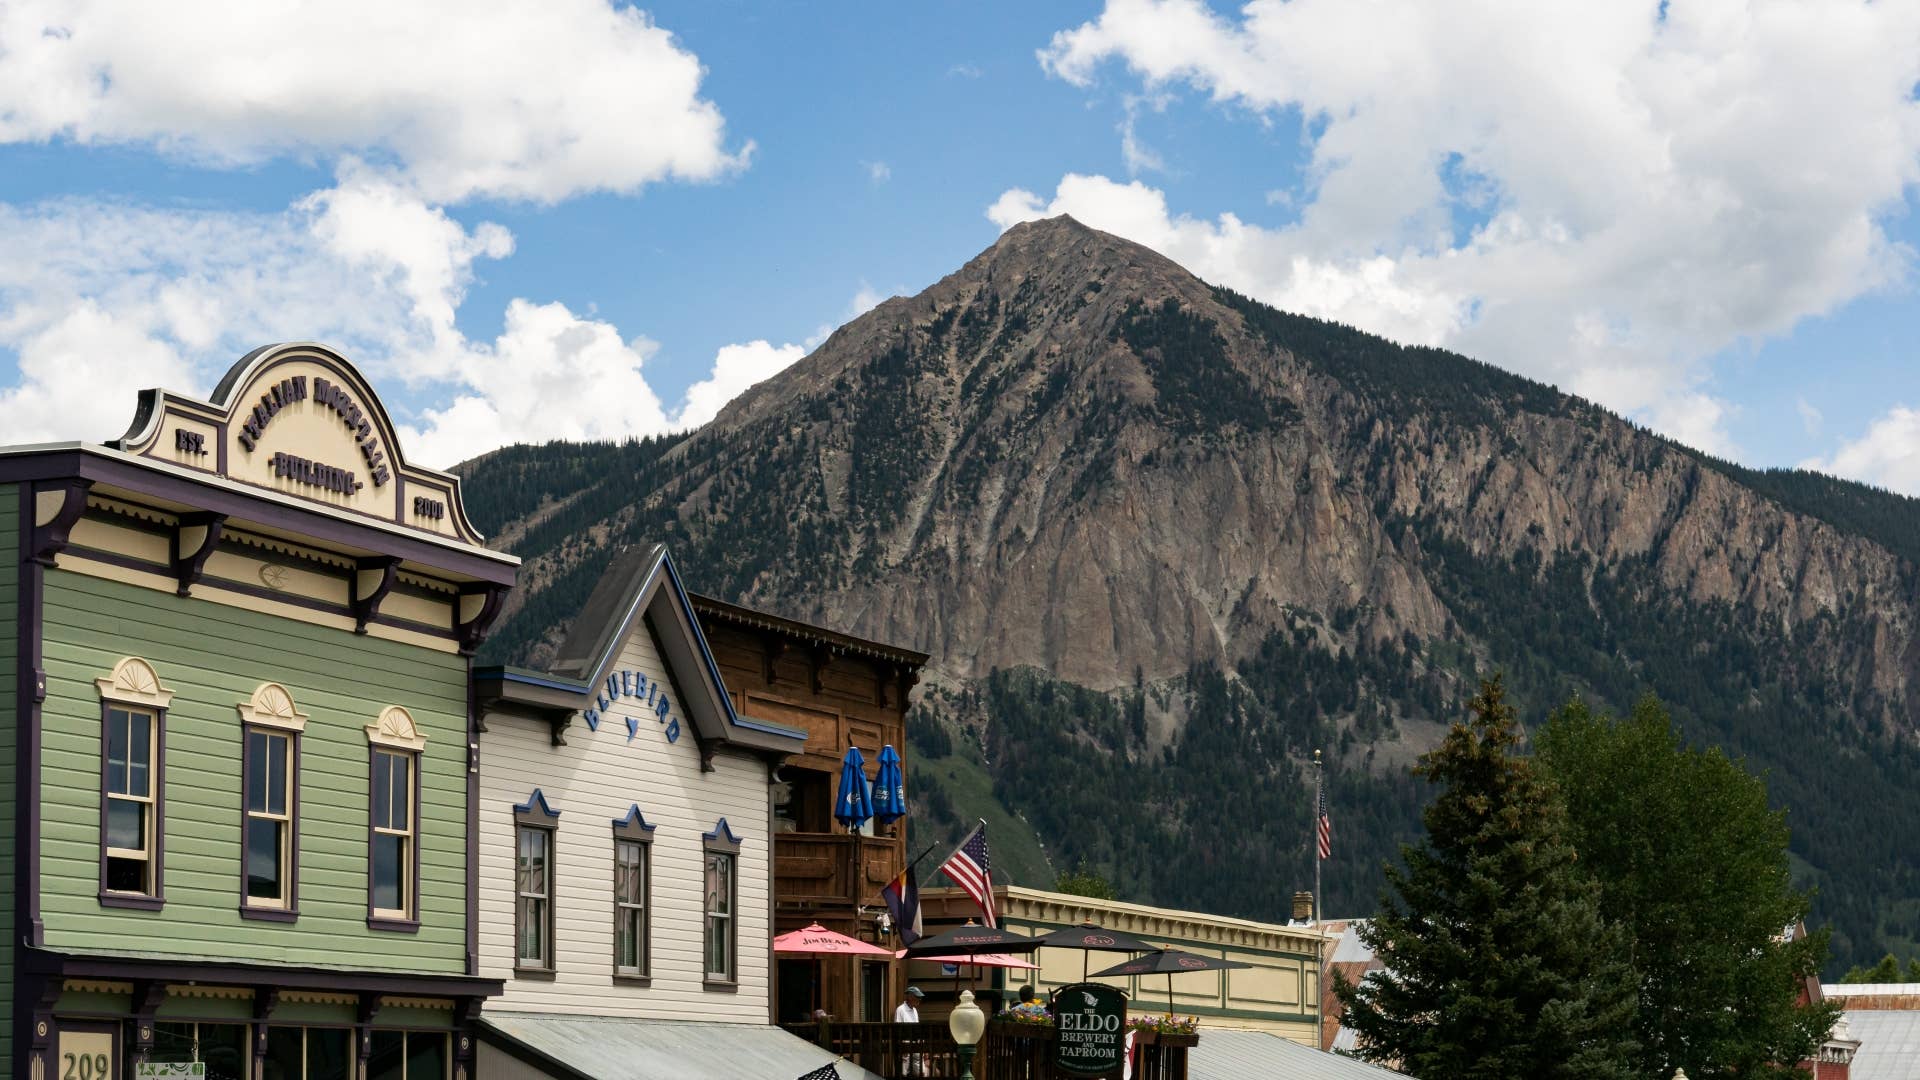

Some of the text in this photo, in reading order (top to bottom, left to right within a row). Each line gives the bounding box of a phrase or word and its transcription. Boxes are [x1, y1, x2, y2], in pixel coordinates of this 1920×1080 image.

[175, 428, 208, 456] EST.
[238, 376, 390, 487] ITALIAN MOUNTAIN
[414, 496, 444, 519] 2000
[1059, 1013, 1119, 1032] ELDO
[1061, 1032, 1116, 1043] BREWERY
[1060, 1046, 1116, 1058] TAPROOM
[64, 1053, 109, 1080] 209
